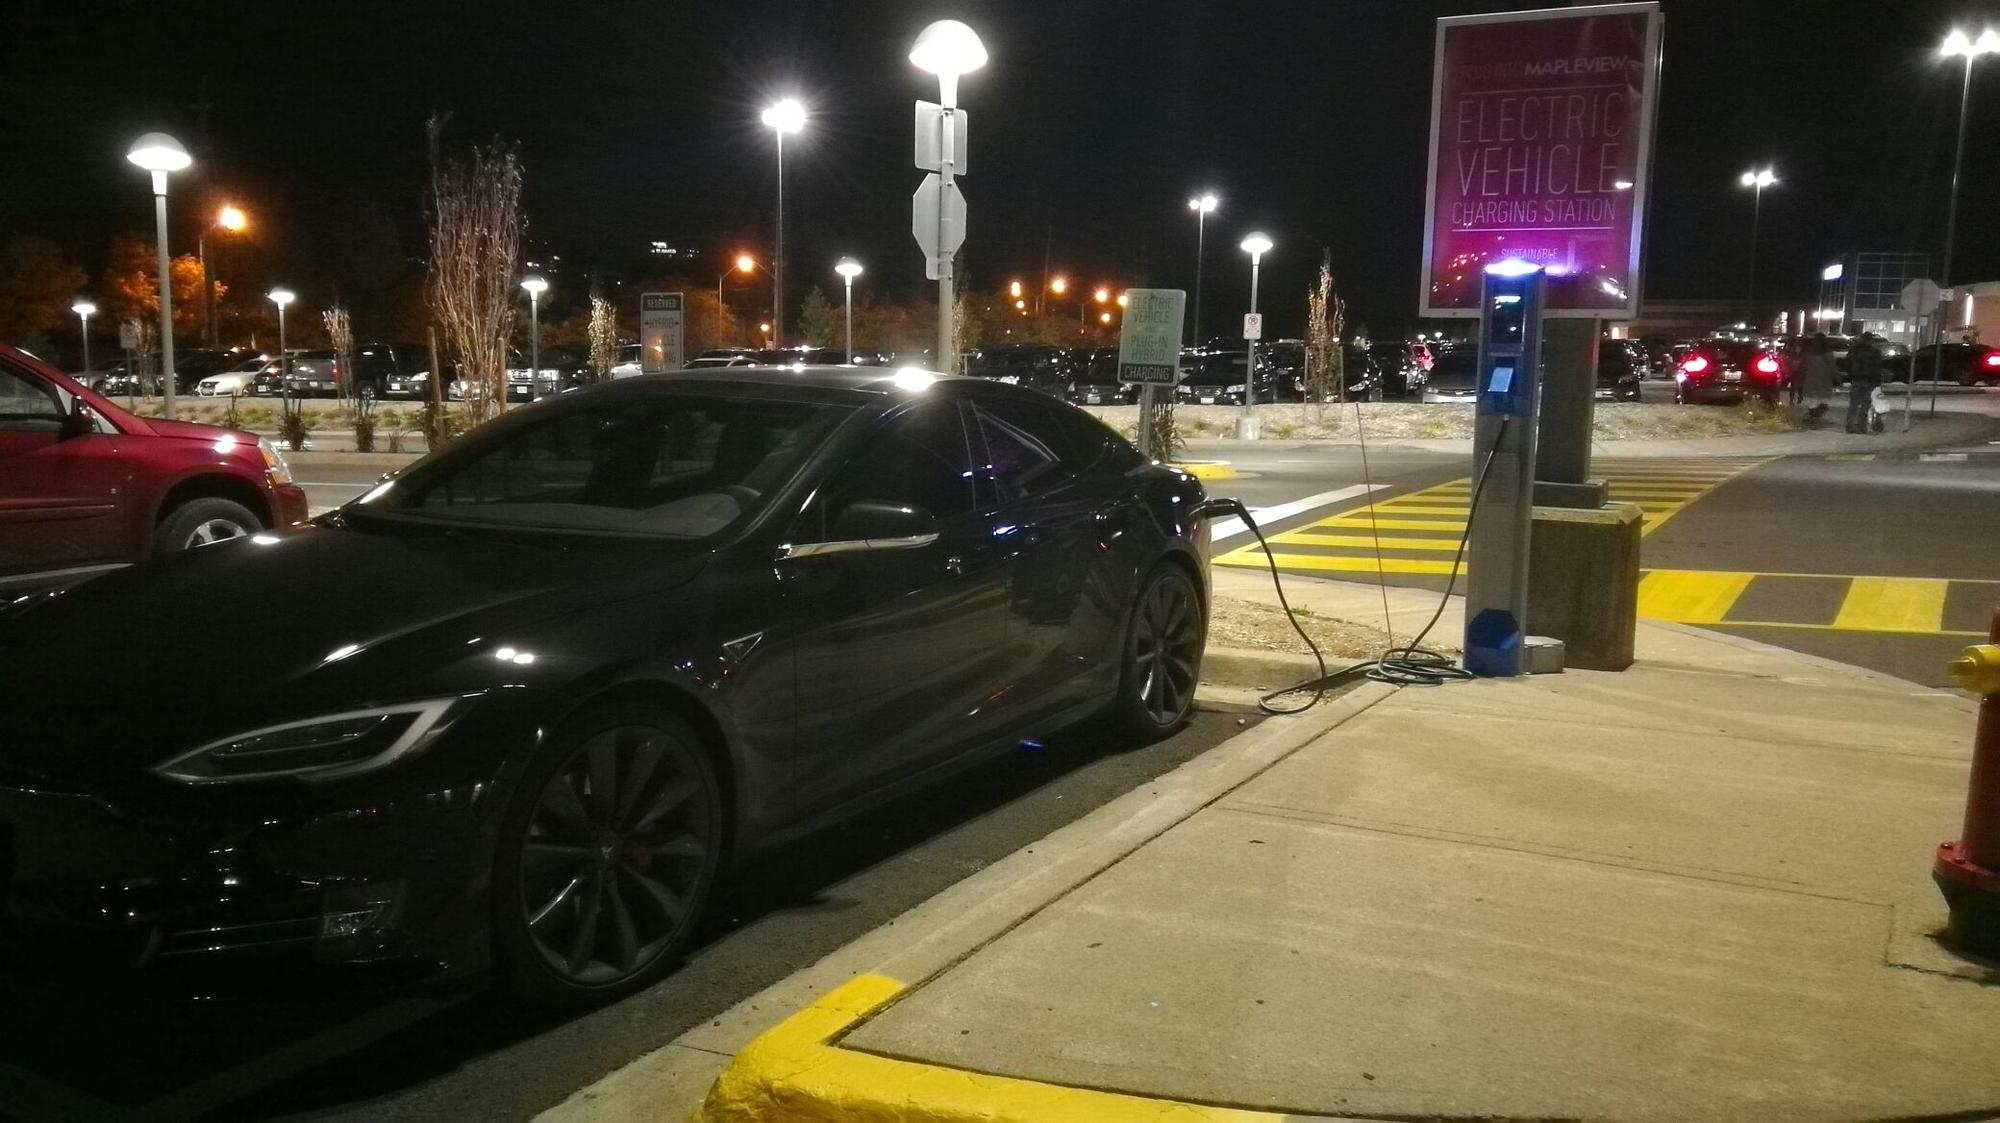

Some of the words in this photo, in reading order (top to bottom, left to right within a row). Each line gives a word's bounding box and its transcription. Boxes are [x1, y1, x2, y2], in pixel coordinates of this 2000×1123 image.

[1524, 55, 1628, 76] MAPLEVIEW
[1456, 92, 1624, 143] ELECTRIC
[1456, 143, 1620, 196] VEHICLE
[1452, 200, 1537, 225] CHARGING
[1544, 199, 1616, 223] STATION
[1500, 248, 1558, 260] SUSTAINABLE
[1130, 335, 1168, 348] PLUG-IN
[1124, 366, 1170, 380] CHARGING
